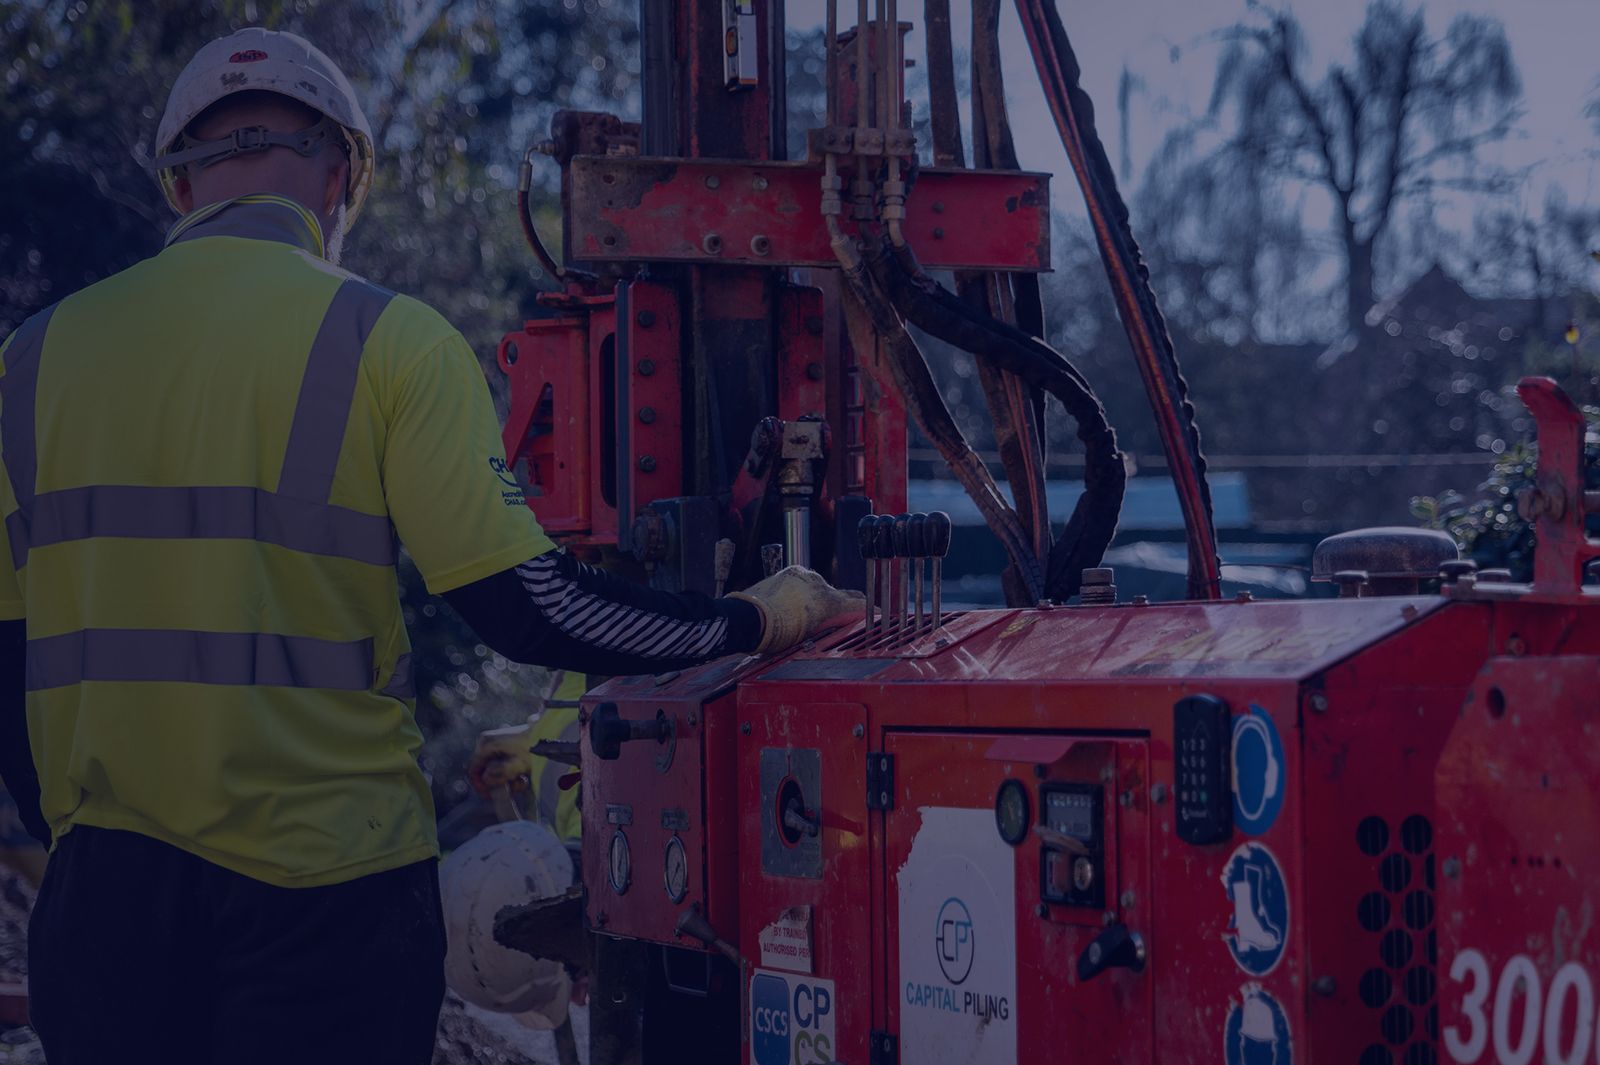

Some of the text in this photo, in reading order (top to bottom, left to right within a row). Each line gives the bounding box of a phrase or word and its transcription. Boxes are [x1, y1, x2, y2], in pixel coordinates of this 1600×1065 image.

[763, 942, 798, 957] AUTHORISED
[794, 983, 830, 1030] CP
[906, 982, 1009, 1020] CAPITAL PILING
[1443, 947, 1600, 1065] 300
[755, 1006, 788, 1037] CSCS
[794, 1030, 831, 1065] CS
